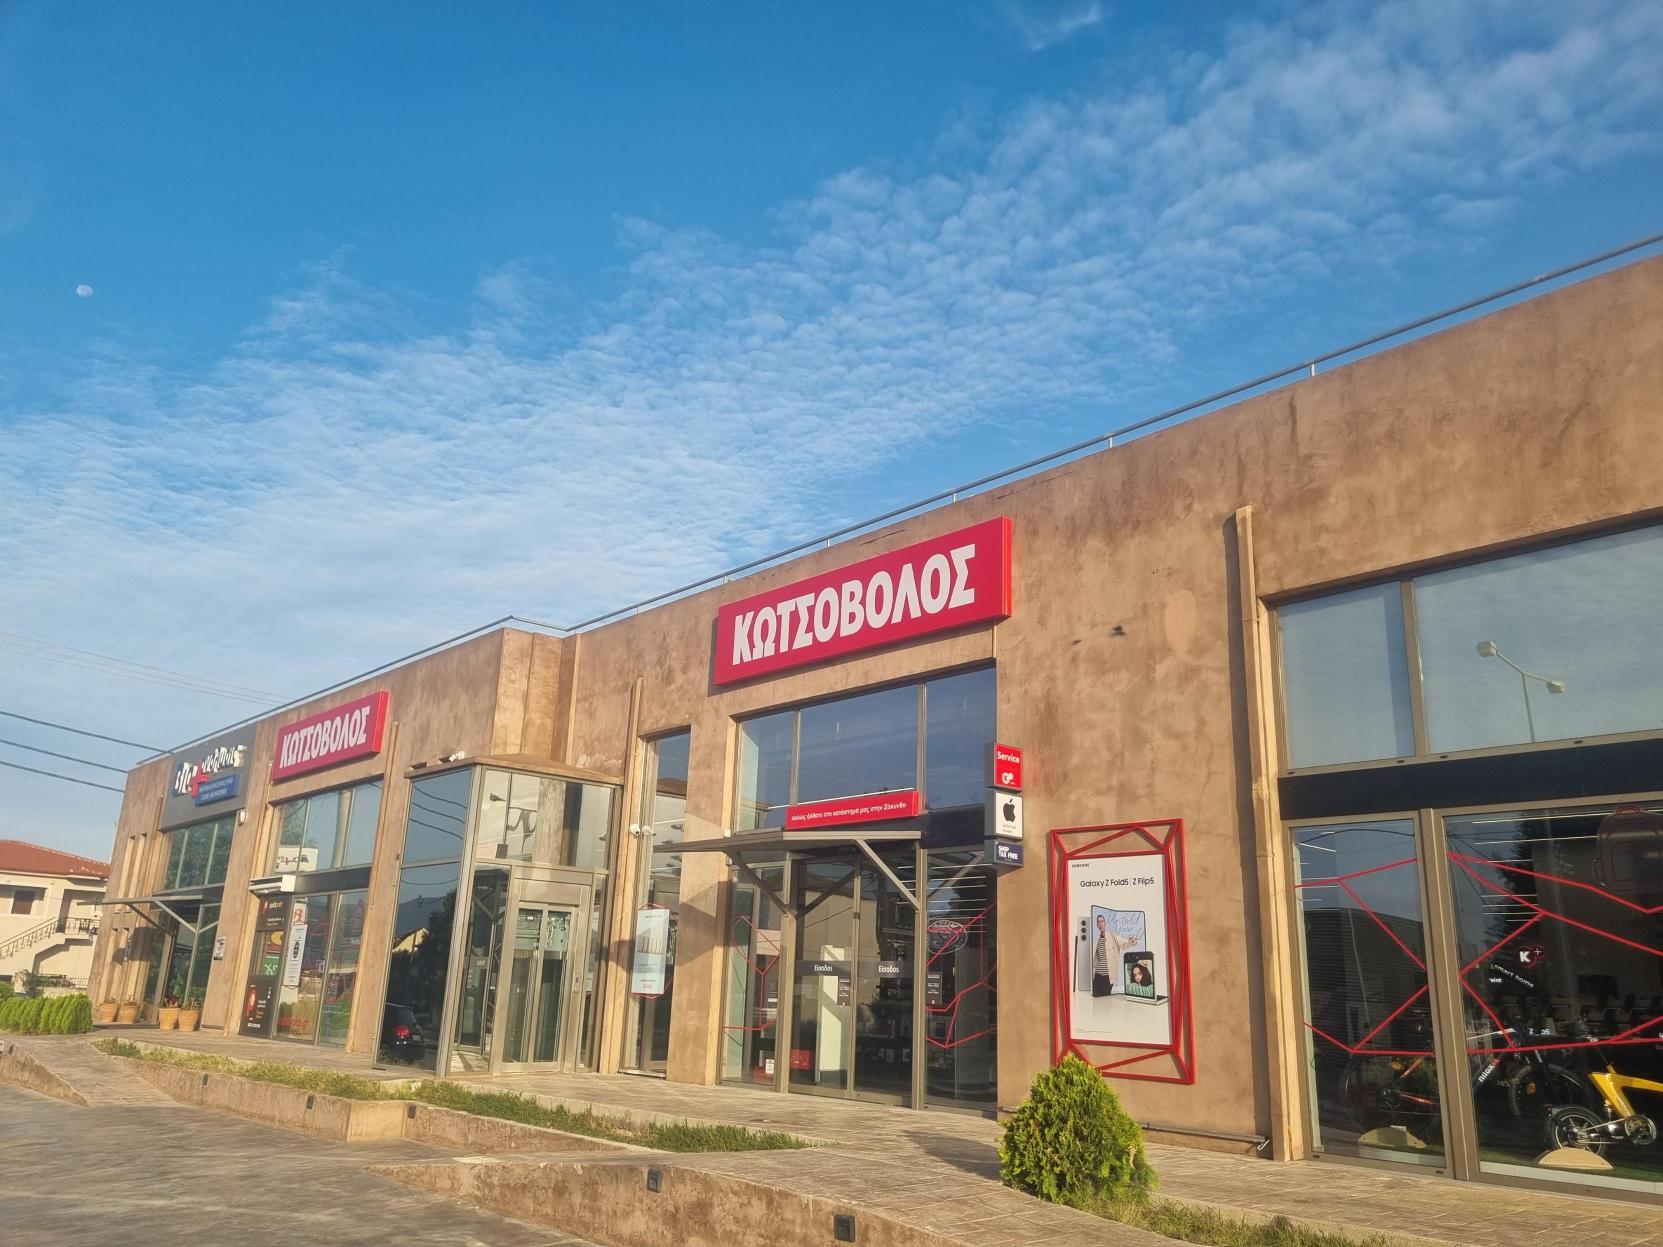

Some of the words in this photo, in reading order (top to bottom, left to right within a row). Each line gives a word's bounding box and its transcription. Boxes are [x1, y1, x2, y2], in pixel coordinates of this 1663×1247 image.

[732, 543, 976, 666] ΚΩΤΣΟΒΟΛΟΣ
[279, 706, 371, 769] ΚΩΤΣΟΒΟΛΟΣ
[997, 751, 1020, 764] Service
[1007, 852, 1019, 860] FREE
[1080, 880, 1105, 888] Galaxy
[1105, 879, 1110, 887] Z
[1110, 878, 1129, 886] Fold5
[1132, 877, 1137, 885] Z
[1137, 876, 1155, 886] Flip5
[1477, 1064, 1496, 1083] nilox
